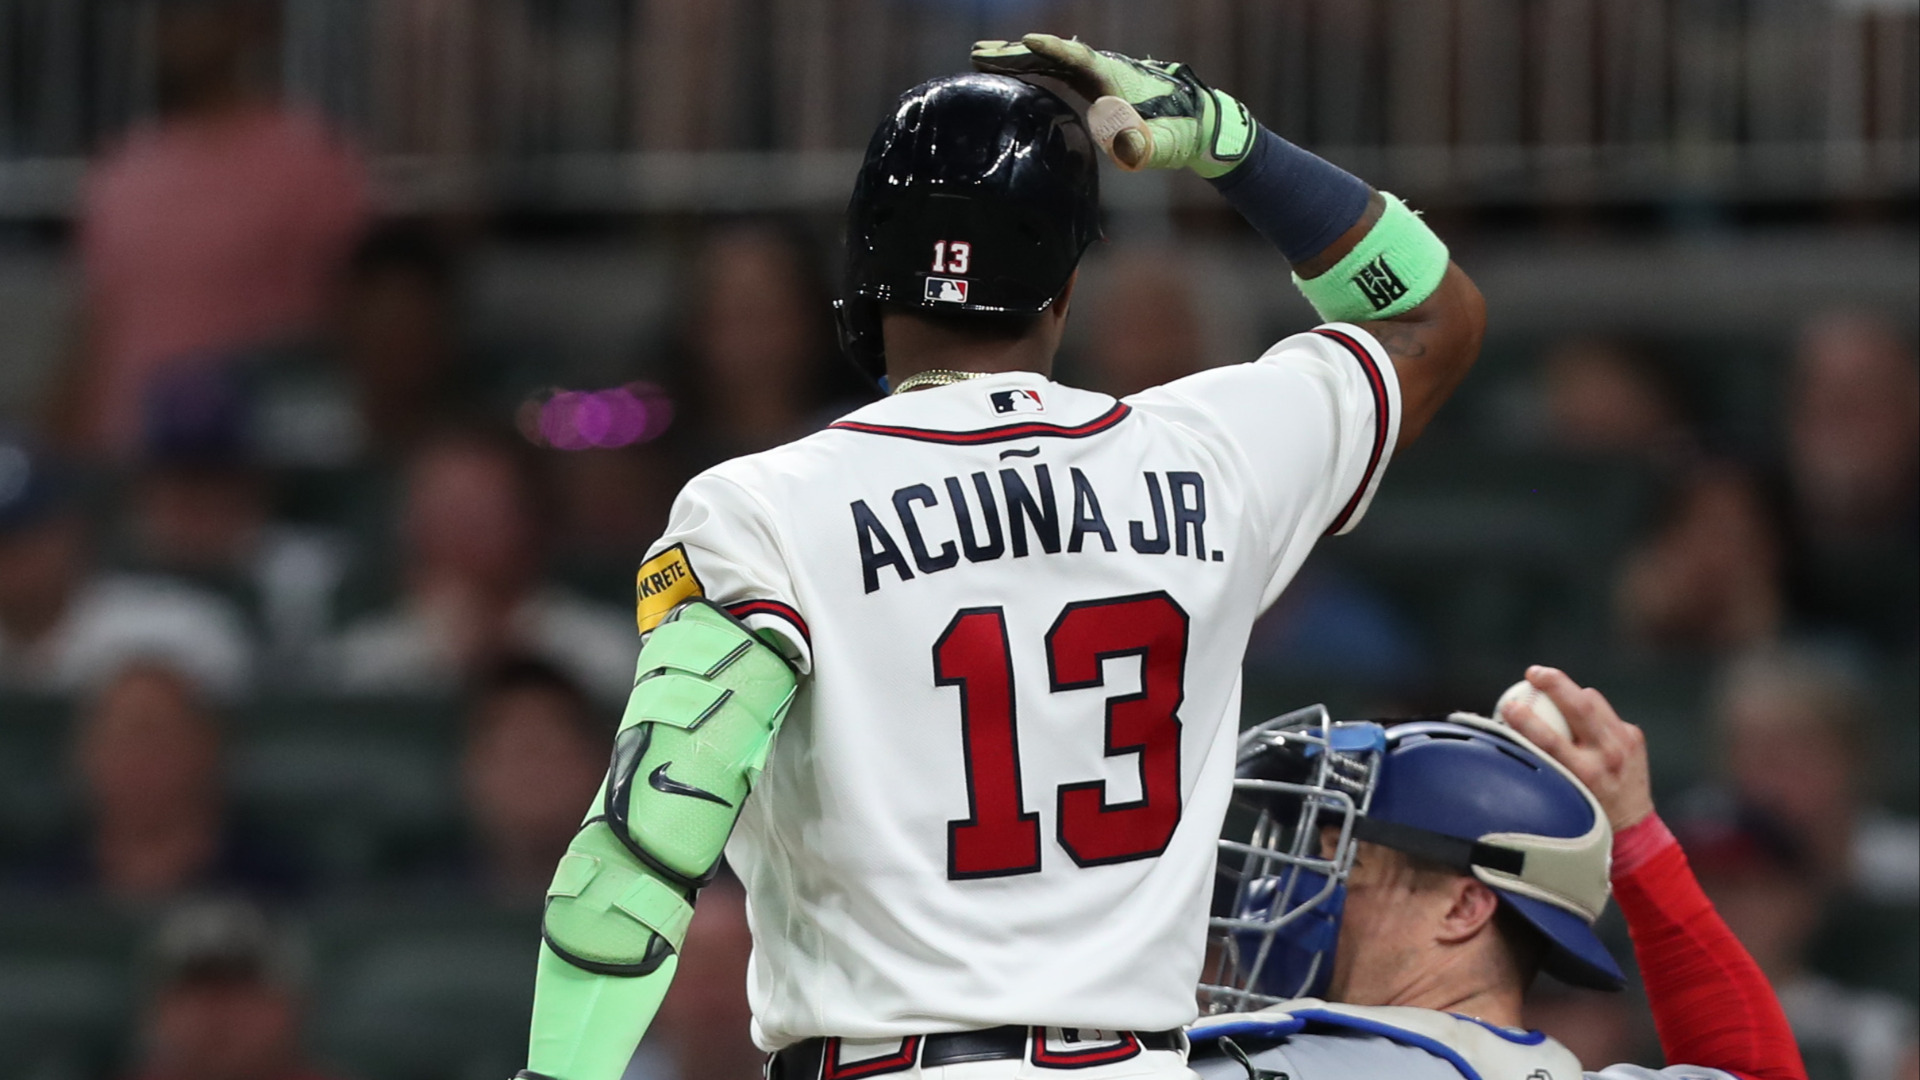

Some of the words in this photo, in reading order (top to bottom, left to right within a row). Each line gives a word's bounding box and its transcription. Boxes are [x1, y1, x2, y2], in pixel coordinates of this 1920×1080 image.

[932, 240, 971, 274] 13
[850, 446, 1117, 594] ACUÑA
[1129, 471, 1224, 562] JR.
[932, 590, 1190, 880] 13
